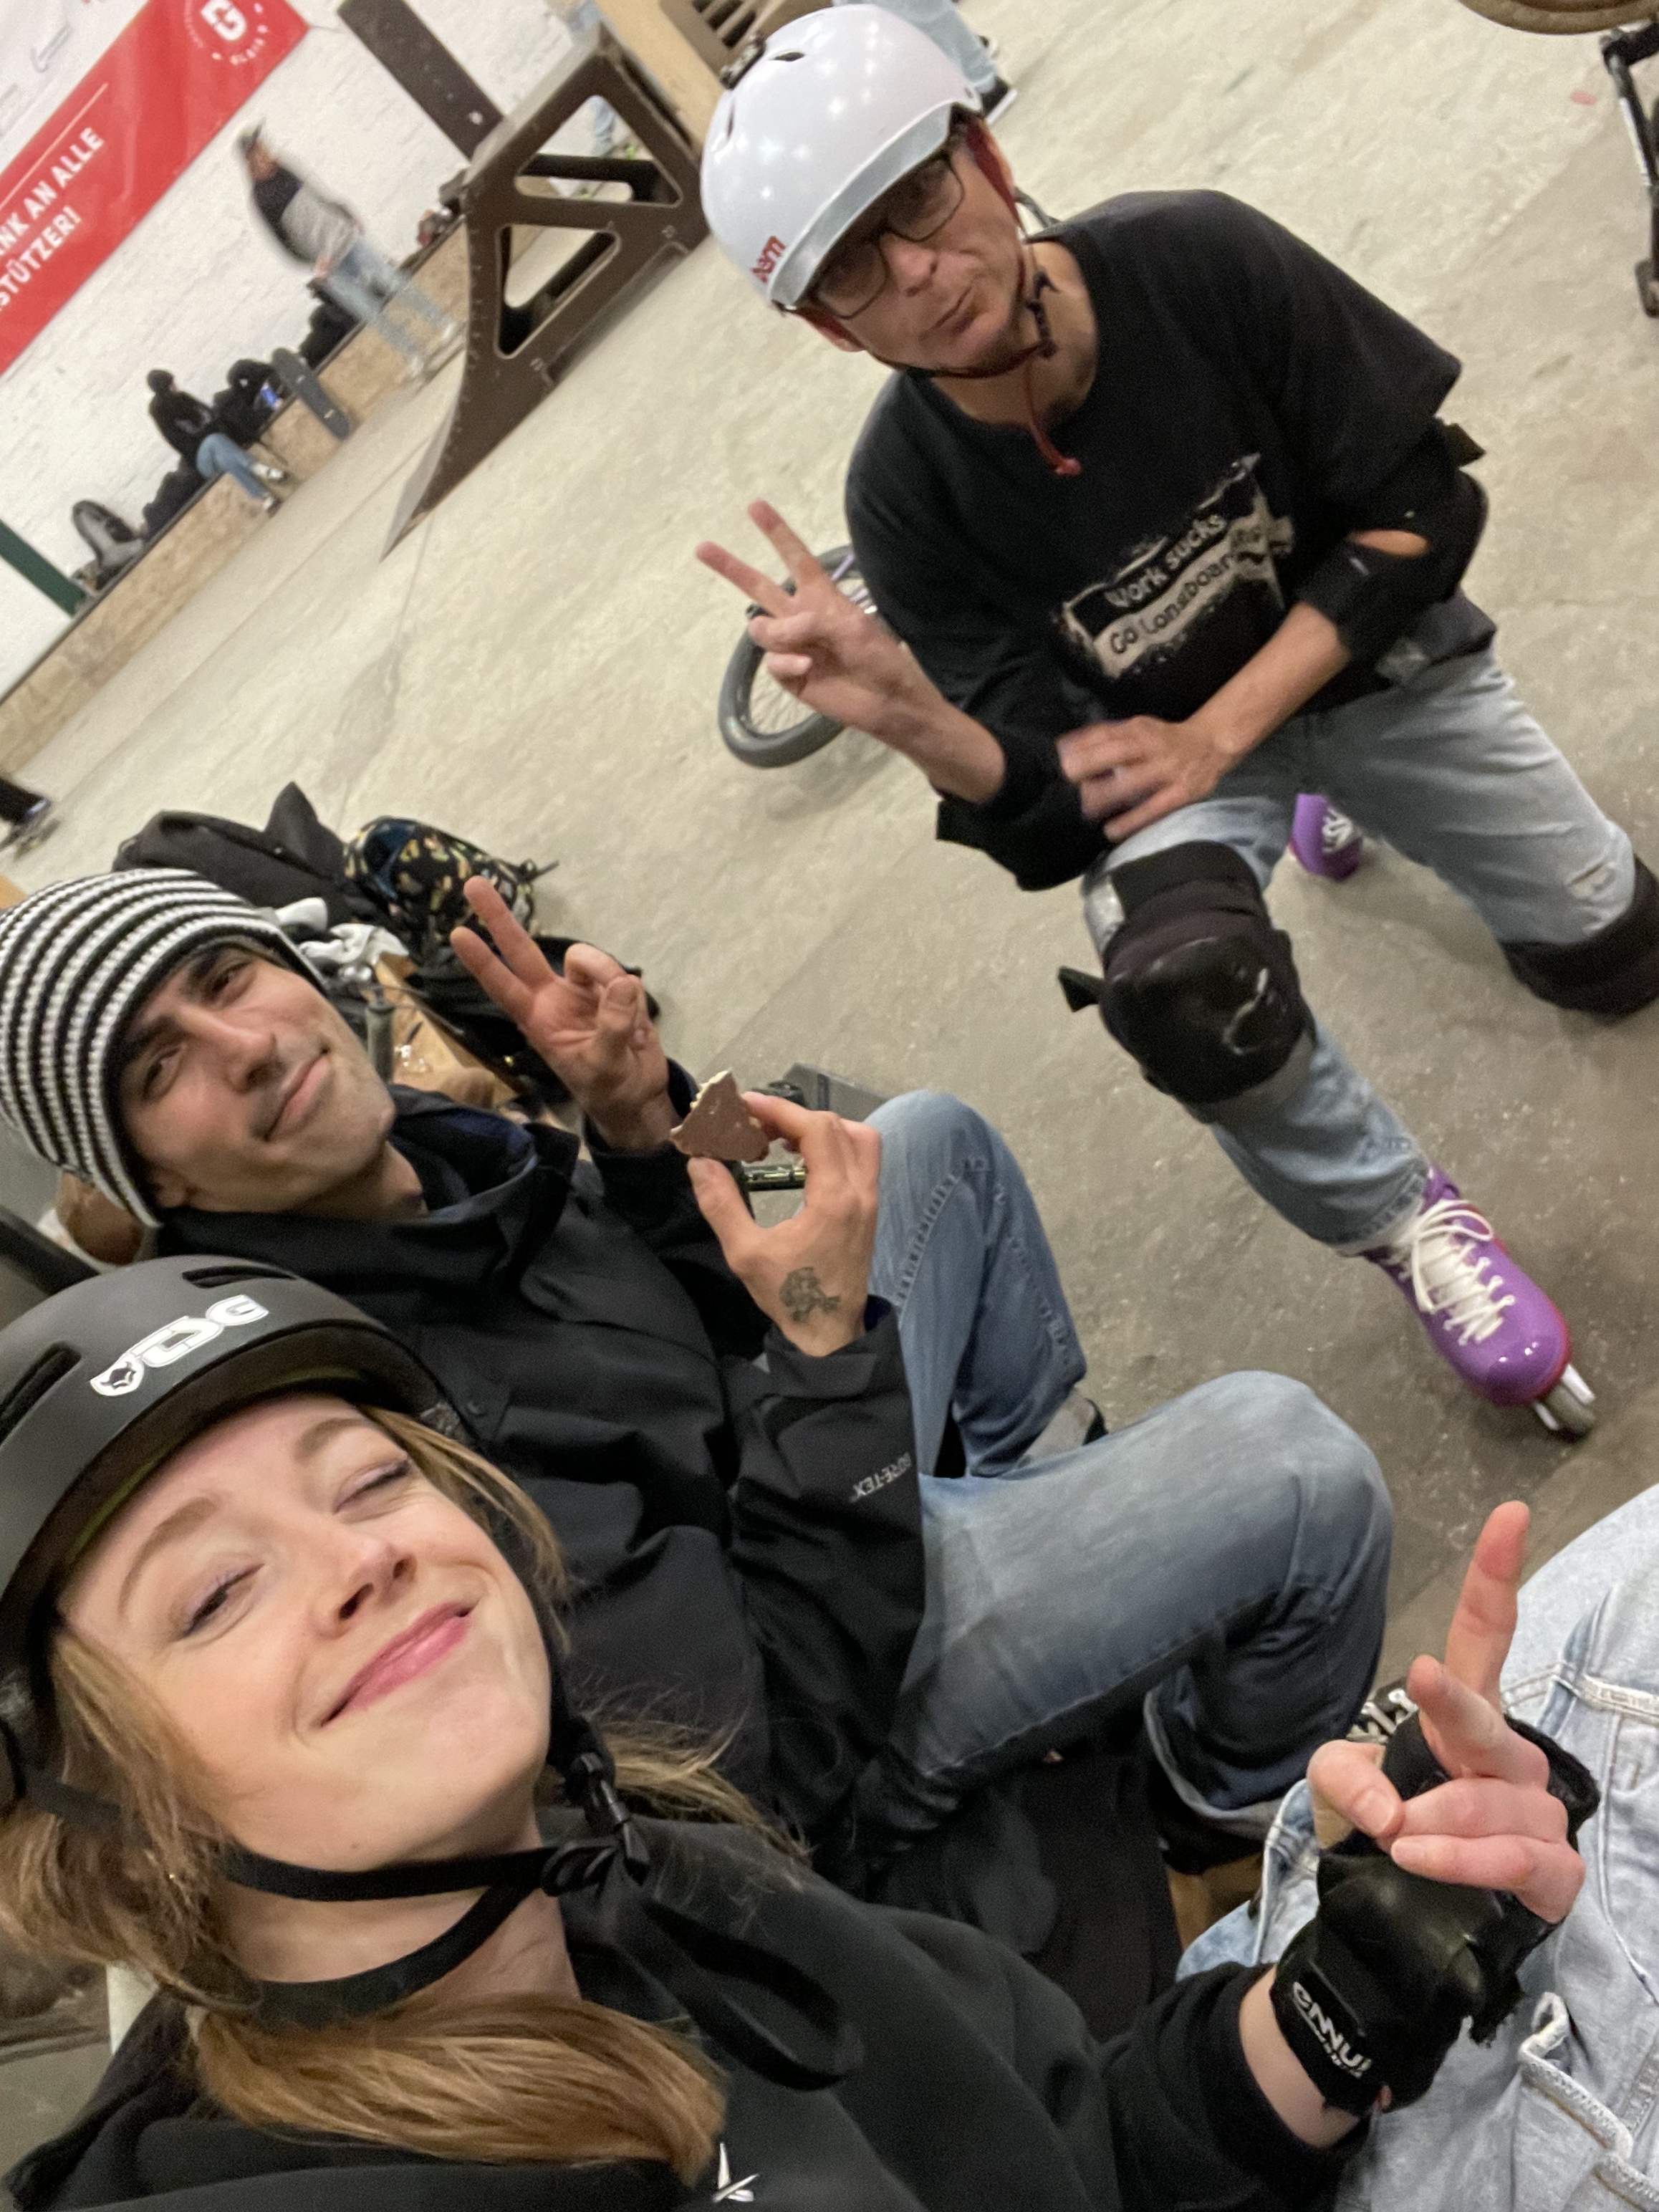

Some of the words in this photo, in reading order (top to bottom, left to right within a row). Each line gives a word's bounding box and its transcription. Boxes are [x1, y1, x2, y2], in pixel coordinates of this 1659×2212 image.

[0, 212, 30, 256] NK
[24, 181, 57, 220] AN
[51, 127, 105, 188] ALLE
[0, 205, 82, 312] STÜTZER!
[1165, 513, 1228, 569] sucks
[1110, 627, 1138, 654] Go
